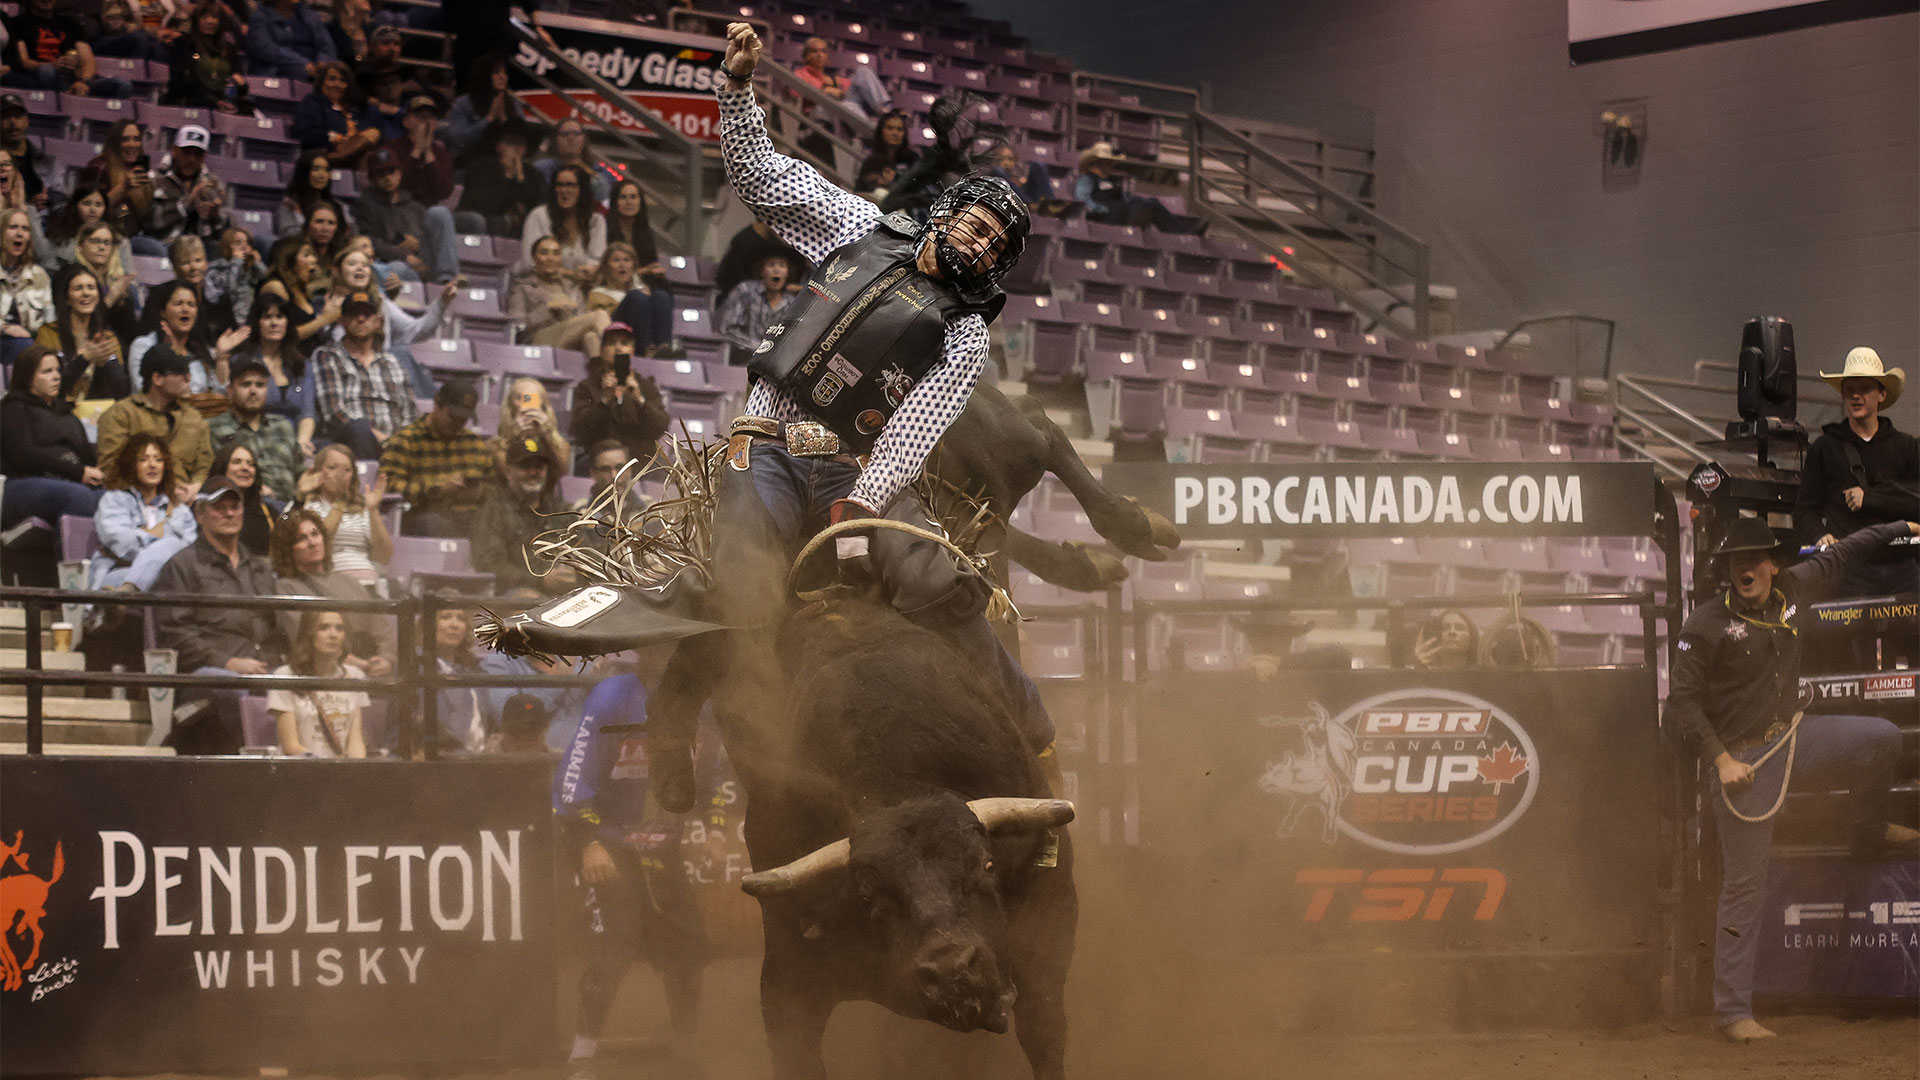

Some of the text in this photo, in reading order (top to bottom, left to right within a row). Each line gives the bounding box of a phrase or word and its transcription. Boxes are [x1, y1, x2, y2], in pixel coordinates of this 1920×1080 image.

[1173, 475, 1584, 525] PBRCANADA.COM
[1818, 608, 1864, 626] Wrangler
[1818, 681, 1860, 699] YETI
[1364, 711, 1484, 733] PBR
[1361, 740, 1488, 752] CANADA
[1352, 755, 1480, 794] CUP
[1351, 796, 1499, 822] SERIES
[89, 830, 525, 950] PENDLETON
[1784, 933, 1840, 949] LEARN
[1849, 932, 1900, 948] MORE
[193, 947, 427, 989] WHISKY
